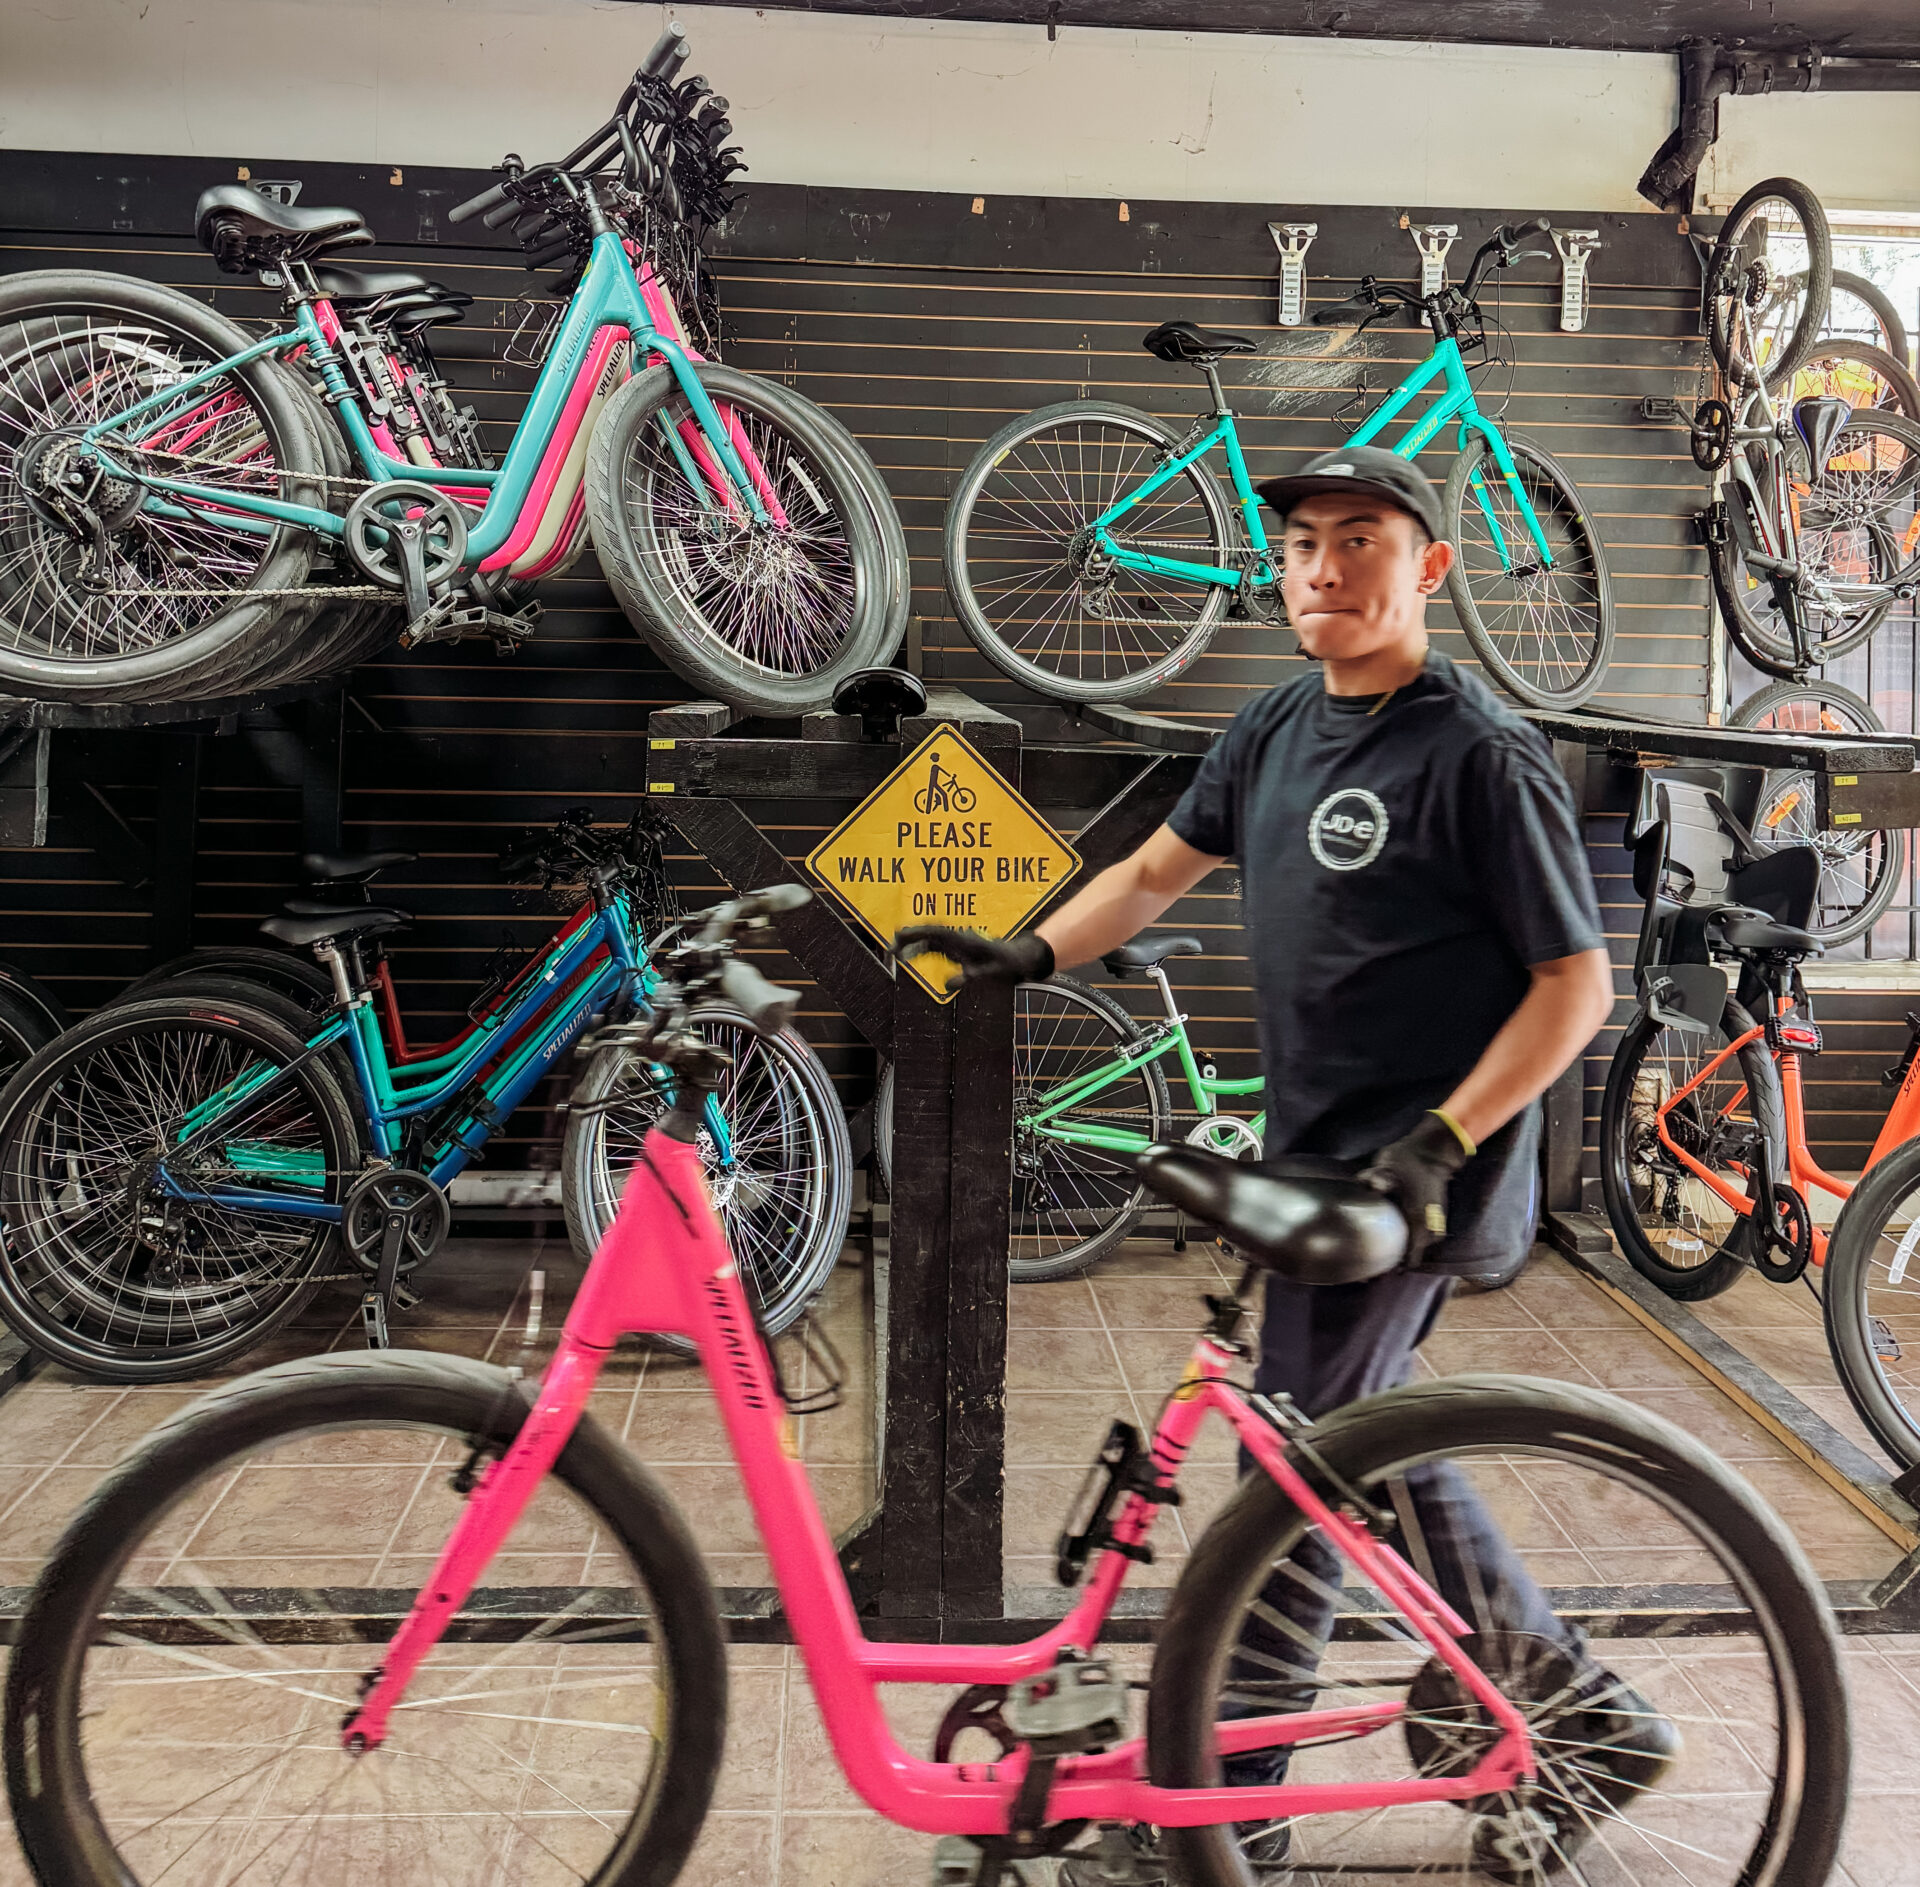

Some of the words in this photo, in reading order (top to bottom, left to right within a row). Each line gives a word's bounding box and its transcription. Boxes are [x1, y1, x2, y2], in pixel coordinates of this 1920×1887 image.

[557, 310, 590, 377] SPECIALIZED
[597, 339, 628, 400] SPECIALIZE
[897, 822, 992, 848] PLEASE
[838, 857, 905, 883] WALK
[920, 857, 985, 882] YOUR
[996, 857, 1050, 882] BIKE
[913, 893, 936, 916] ON
[945, 893, 976, 916] THE
[543, 1003, 592, 1060] SPECIALIZED
